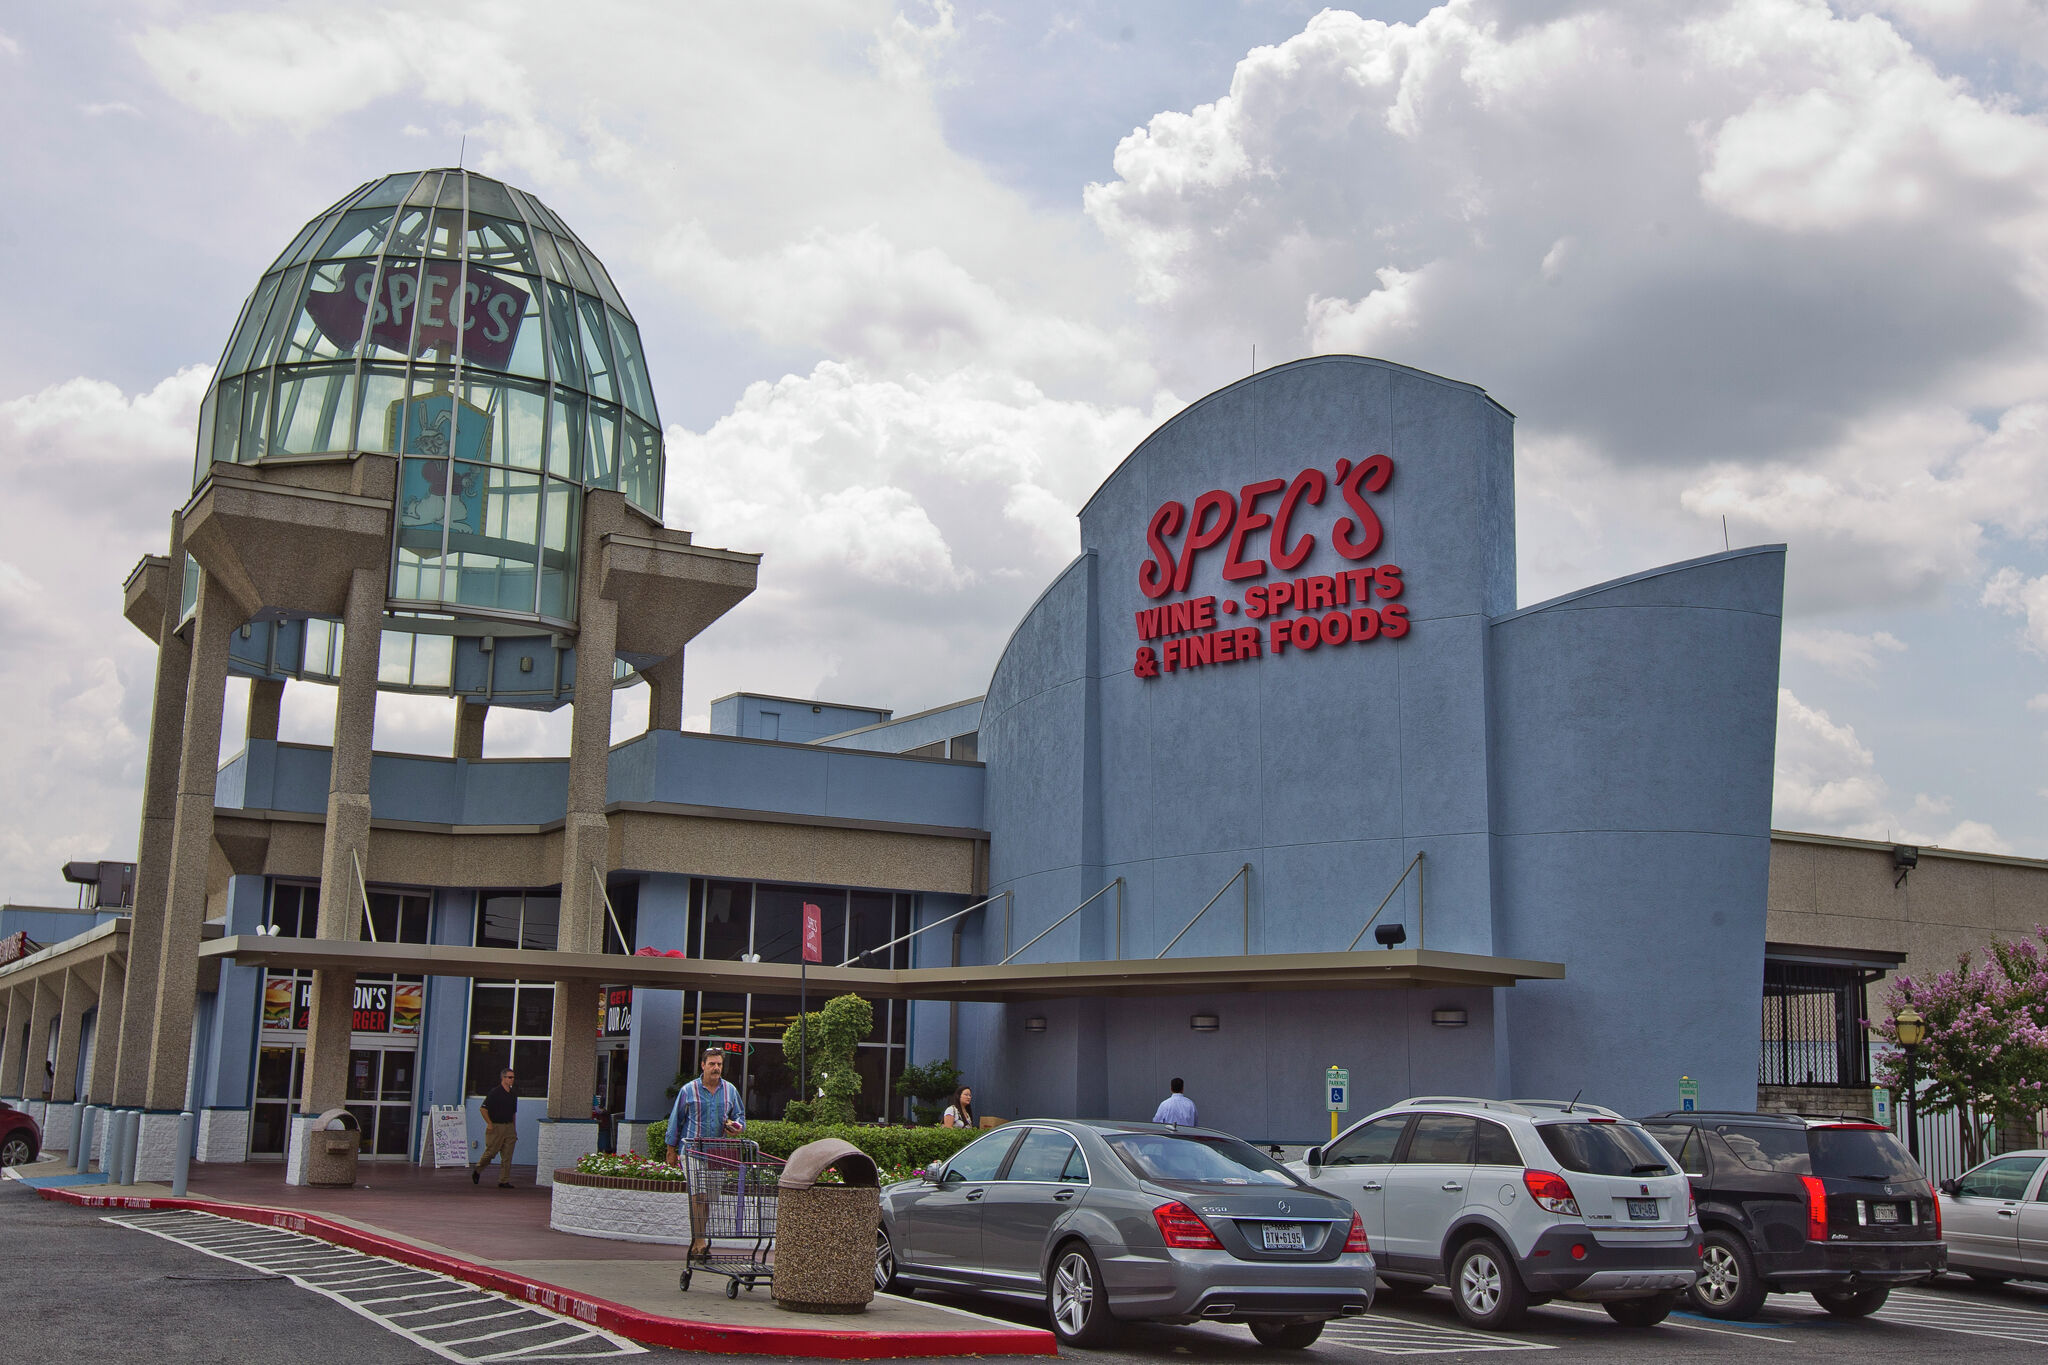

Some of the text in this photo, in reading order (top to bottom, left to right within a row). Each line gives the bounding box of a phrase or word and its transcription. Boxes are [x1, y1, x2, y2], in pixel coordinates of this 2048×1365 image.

[354, 272, 518, 342] SPEC'S
[1138, 454, 1394, 599] SPEC'S
[1135, 564, 1404, 641] WINE SPIRITS
[1133, 603, 1411, 678] & FINER FOODS
[124, 1197, 151, 1208] PARKING
[526, 1284, 598, 1322] FIRE LANE NO PARKING
